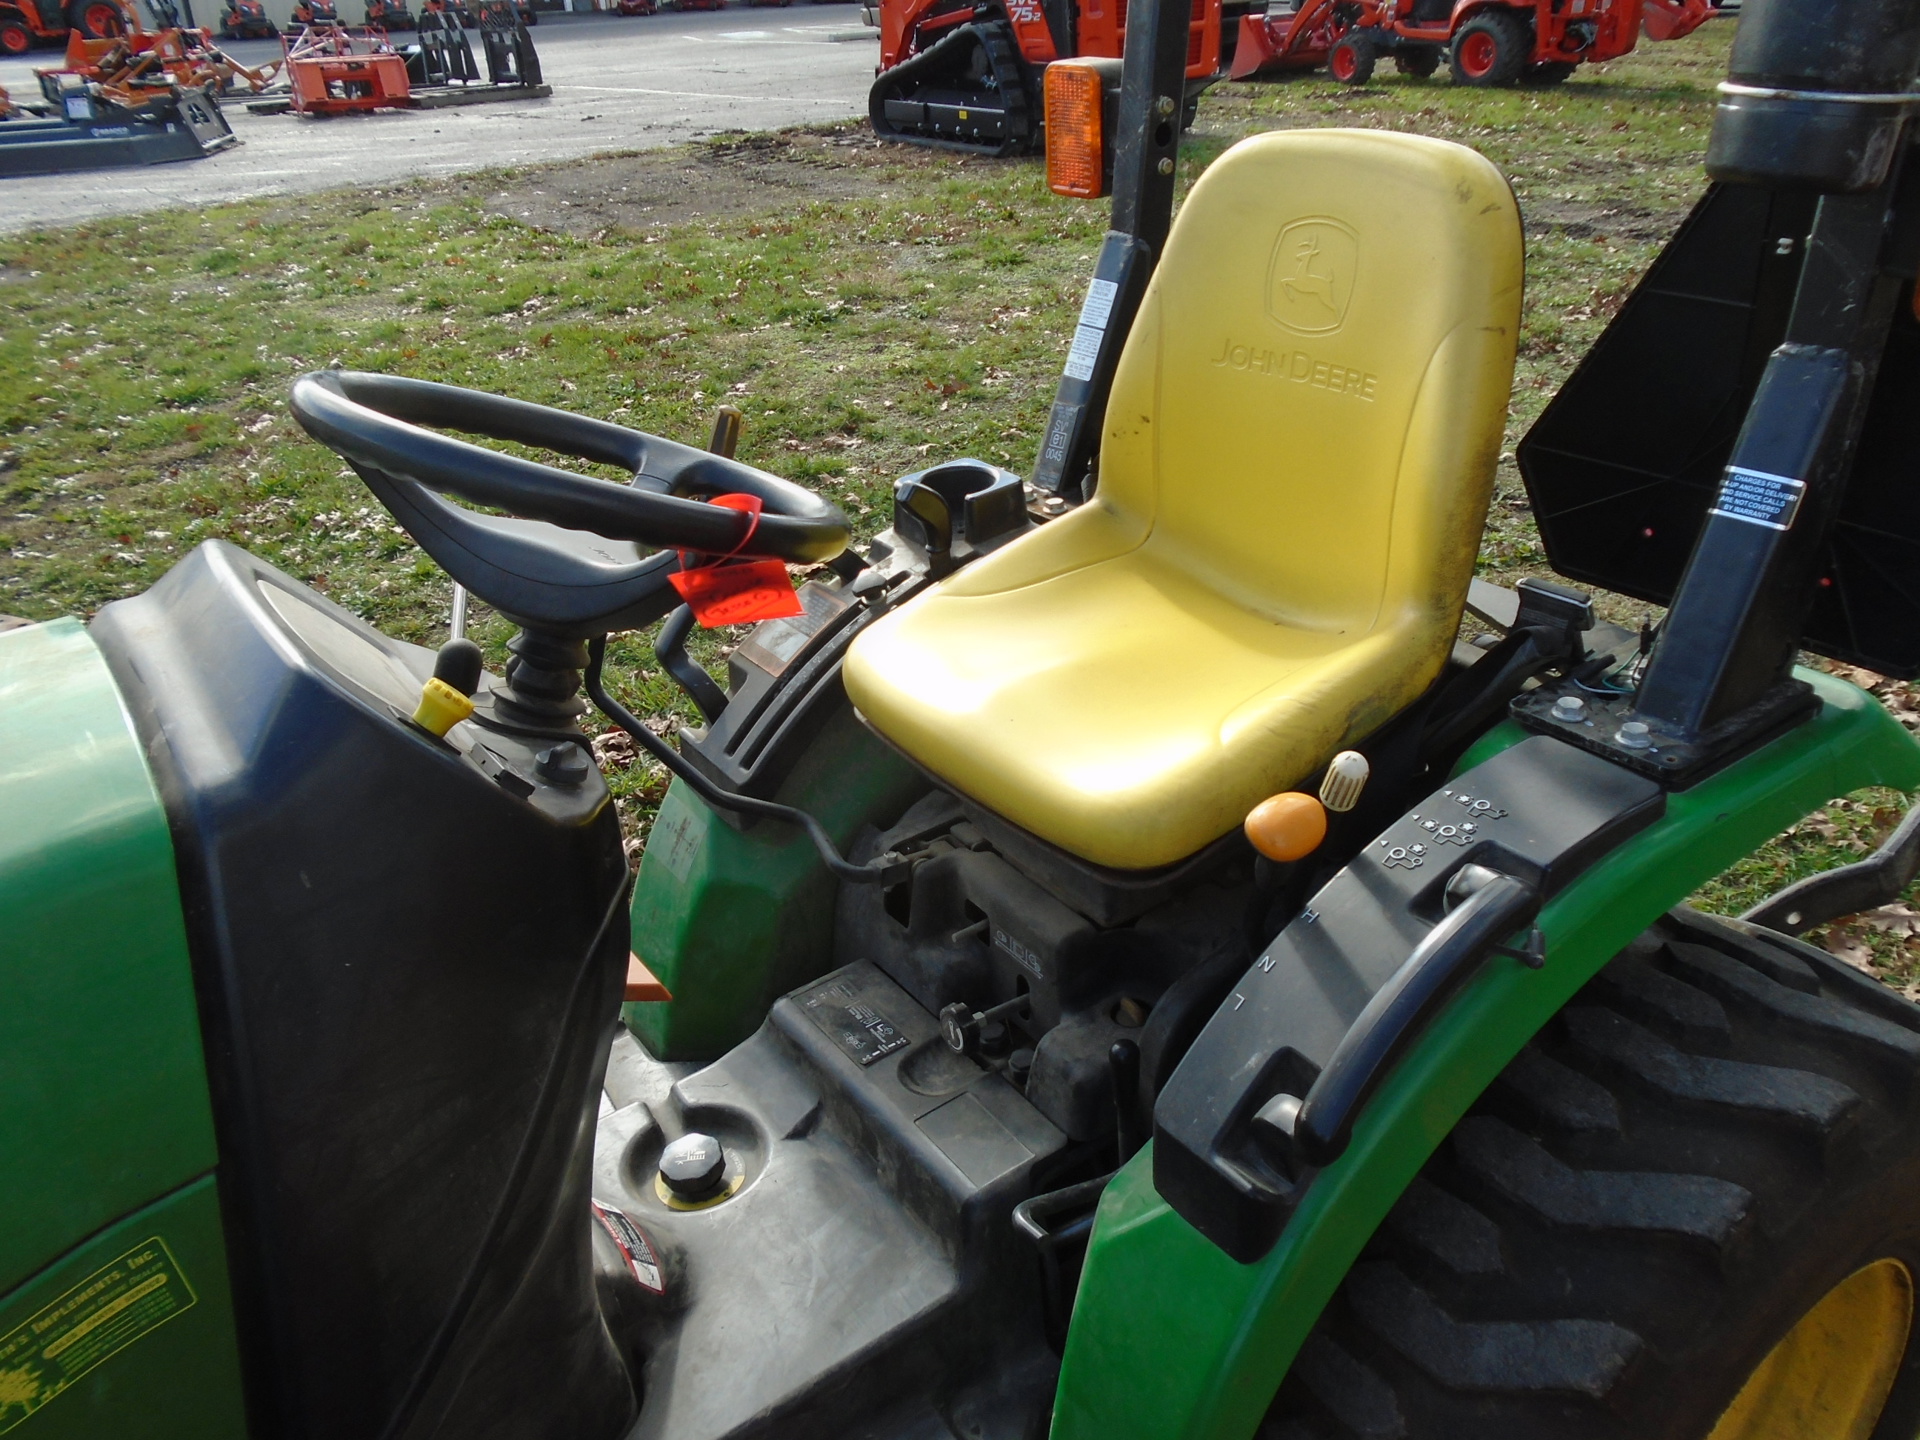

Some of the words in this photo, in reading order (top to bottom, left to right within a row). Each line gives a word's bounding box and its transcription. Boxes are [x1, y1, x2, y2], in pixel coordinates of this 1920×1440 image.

[1211, 338, 1287, 379] JOHN
[1290, 350, 1378, 402] DEERE
[1046, 448, 1063, 462] 0045
[1734, 474, 1767, 487] CHARGES
[1766, 482, 1782, 490] FOR
[1734, 490, 1762, 501] SERVICE
[1762, 497, 1786, 508] CALLS
[1765, 489, 1799, 502] DELIVERY
[1720, 495, 1734, 503] ARE
[1734, 498, 1748, 506] NOT
[1748, 501, 1781, 514] COVERED
[1723, 503, 1733, 511] BY
[1733, 506, 1771, 520] WARRANTY
[1301, 907, 1320, 924] H
[1258, 955, 1276, 973] N
[1234, 993, 1246, 1011] L
